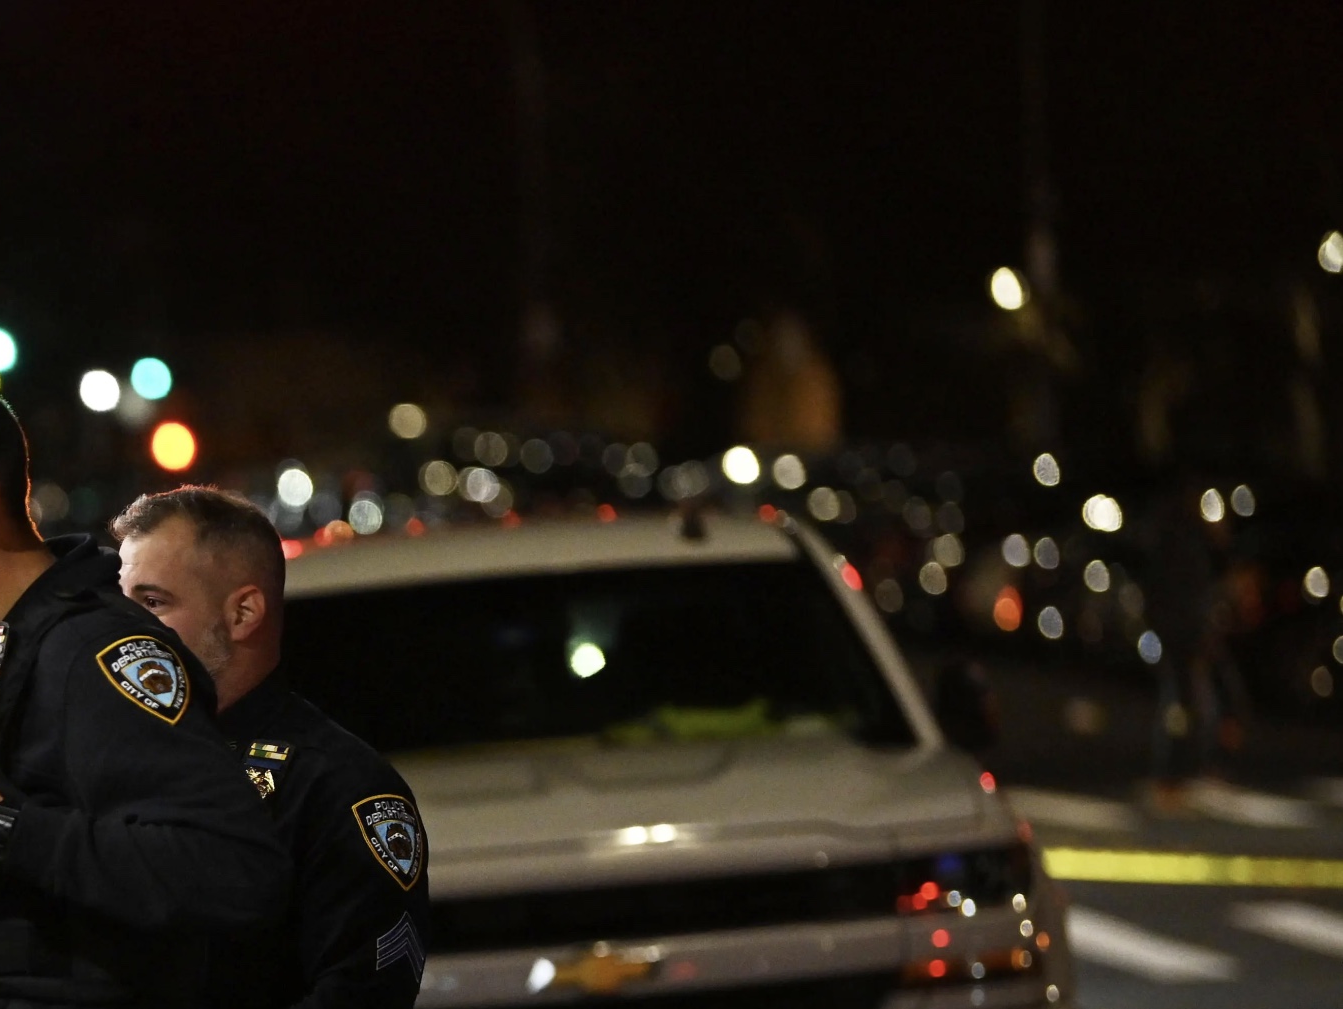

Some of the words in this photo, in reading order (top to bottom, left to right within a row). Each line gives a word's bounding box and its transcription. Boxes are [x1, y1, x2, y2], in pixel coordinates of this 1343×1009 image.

[119, 640, 156, 655] POLICE
[120, 681, 144, 698] CITY
[144, 698, 159, 709] OF
[374, 801, 405, 812] POLICE
[371, 837, 388, 859] CITY
[387, 860, 399, 873] OF
